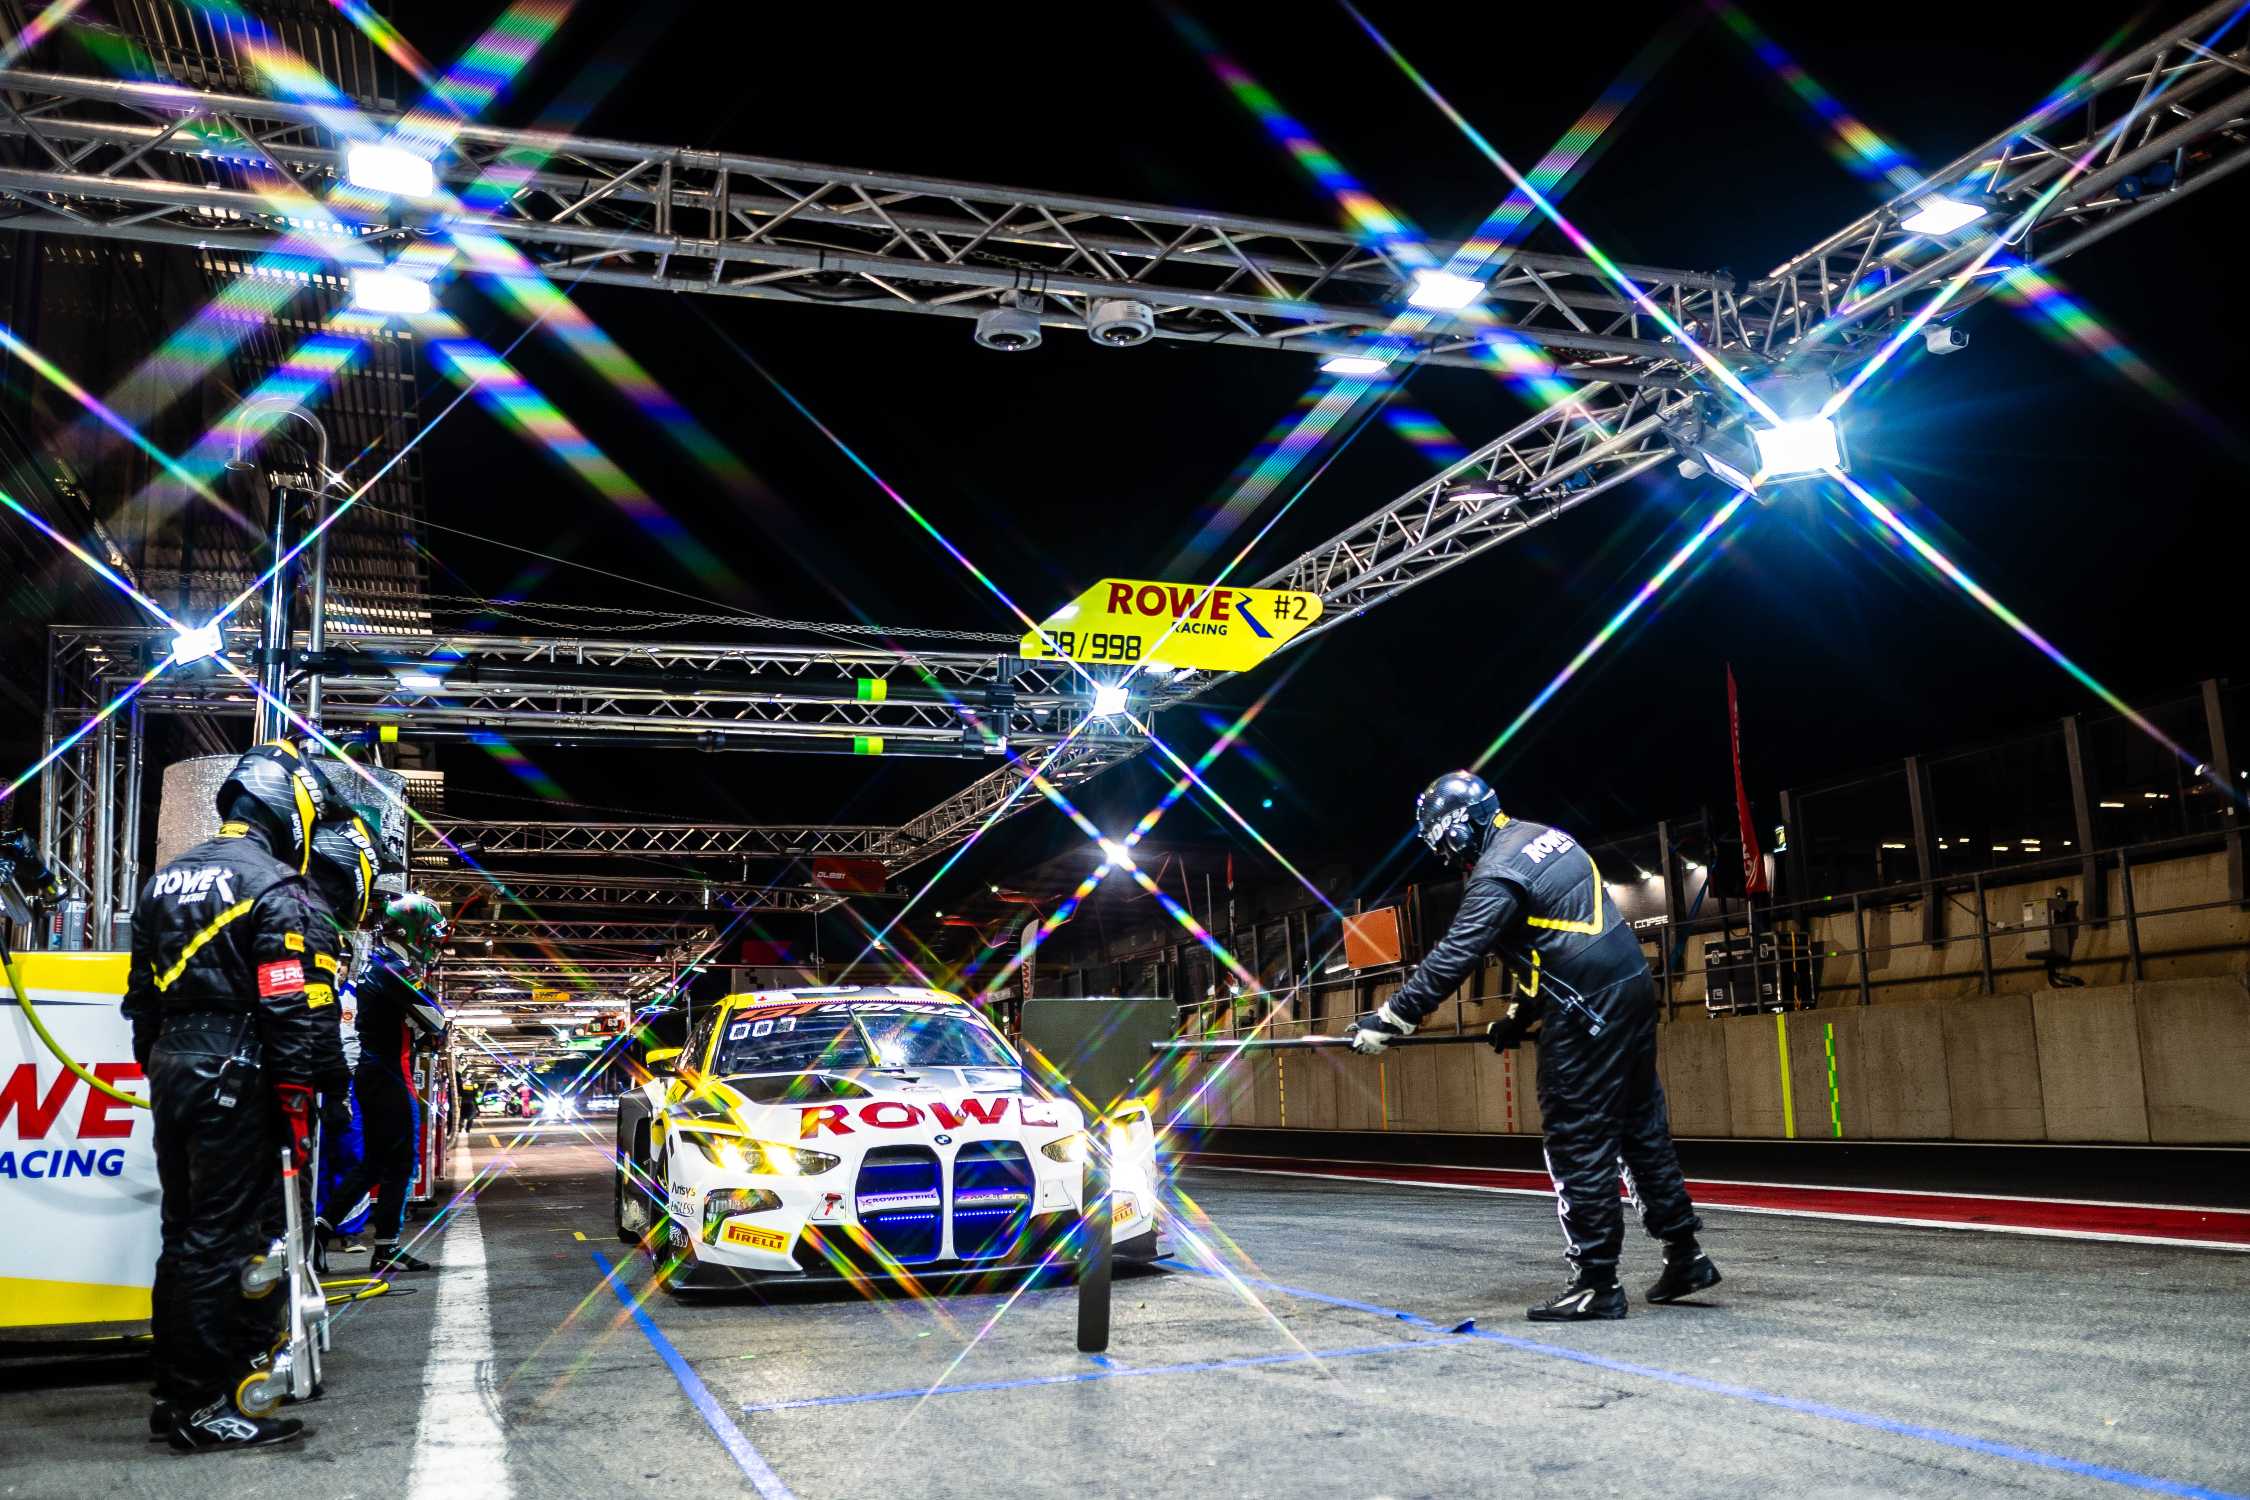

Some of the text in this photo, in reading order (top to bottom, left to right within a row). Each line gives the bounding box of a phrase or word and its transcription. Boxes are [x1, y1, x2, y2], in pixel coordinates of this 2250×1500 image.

[1107, 583, 1232, 620] ROWE
[1274, 594, 1308, 621] #2
[1171, 621, 1228, 636] RACING
[153, 867, 221, 898] ROWE
[728, 1225, 785, 1249] PIRELLI
